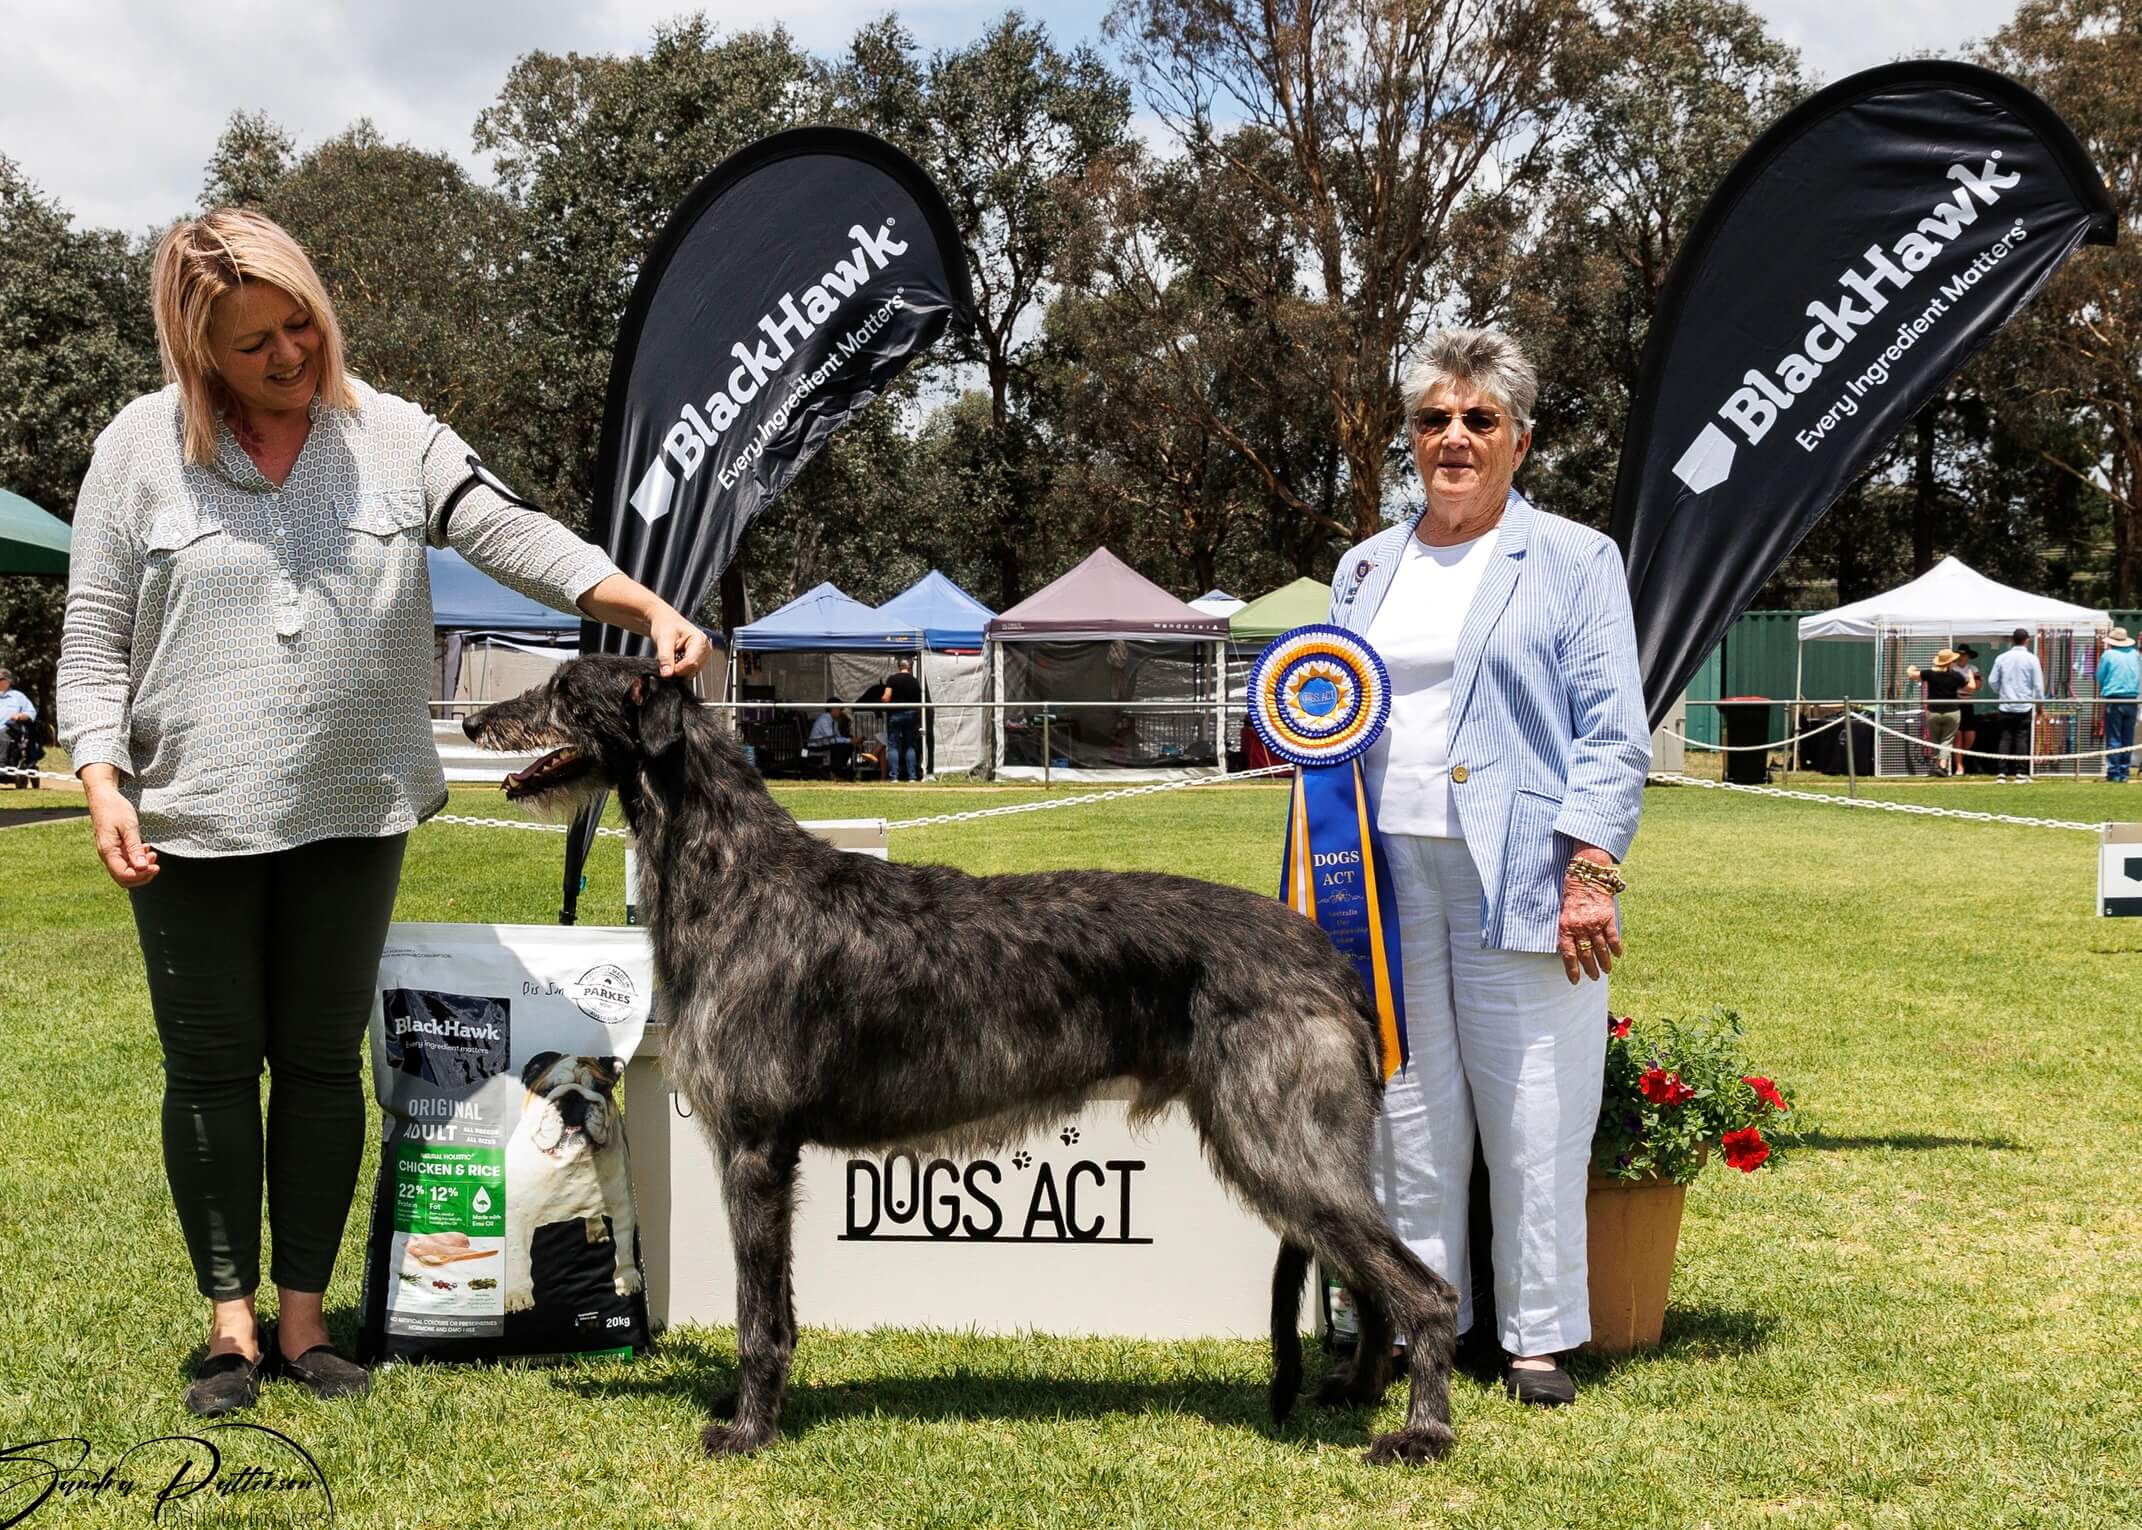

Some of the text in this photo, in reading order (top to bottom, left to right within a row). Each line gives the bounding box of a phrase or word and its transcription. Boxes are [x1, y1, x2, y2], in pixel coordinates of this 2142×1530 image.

[1795, 397, 1858, 452] Every
[1846, 297, 1950, 398] Ingredient
[717, 442, 764, 490] Every
[757, 352, 844, 442] Ingredient
[1313, 850, 1360, 867] DOGS
[1322, 870, 1355, 886] ACT
[583, 987, 631, 1005] PARKES
[395, 1016, 501, 1041] BlackHawk
[408, 1098, 483, 1121] ORIGINAL
[403, 1122, 458, 1141] ADULT
[398, 1160, 501, 1178] CHICKEN & RICE
[430, 1186, 459, 1202] 12%
[847, 1150, 1146, 1240] DOGS ACT
[429, 1202, 441, 1211] Fat
[605, 1315, 631, 1328] 20kg
